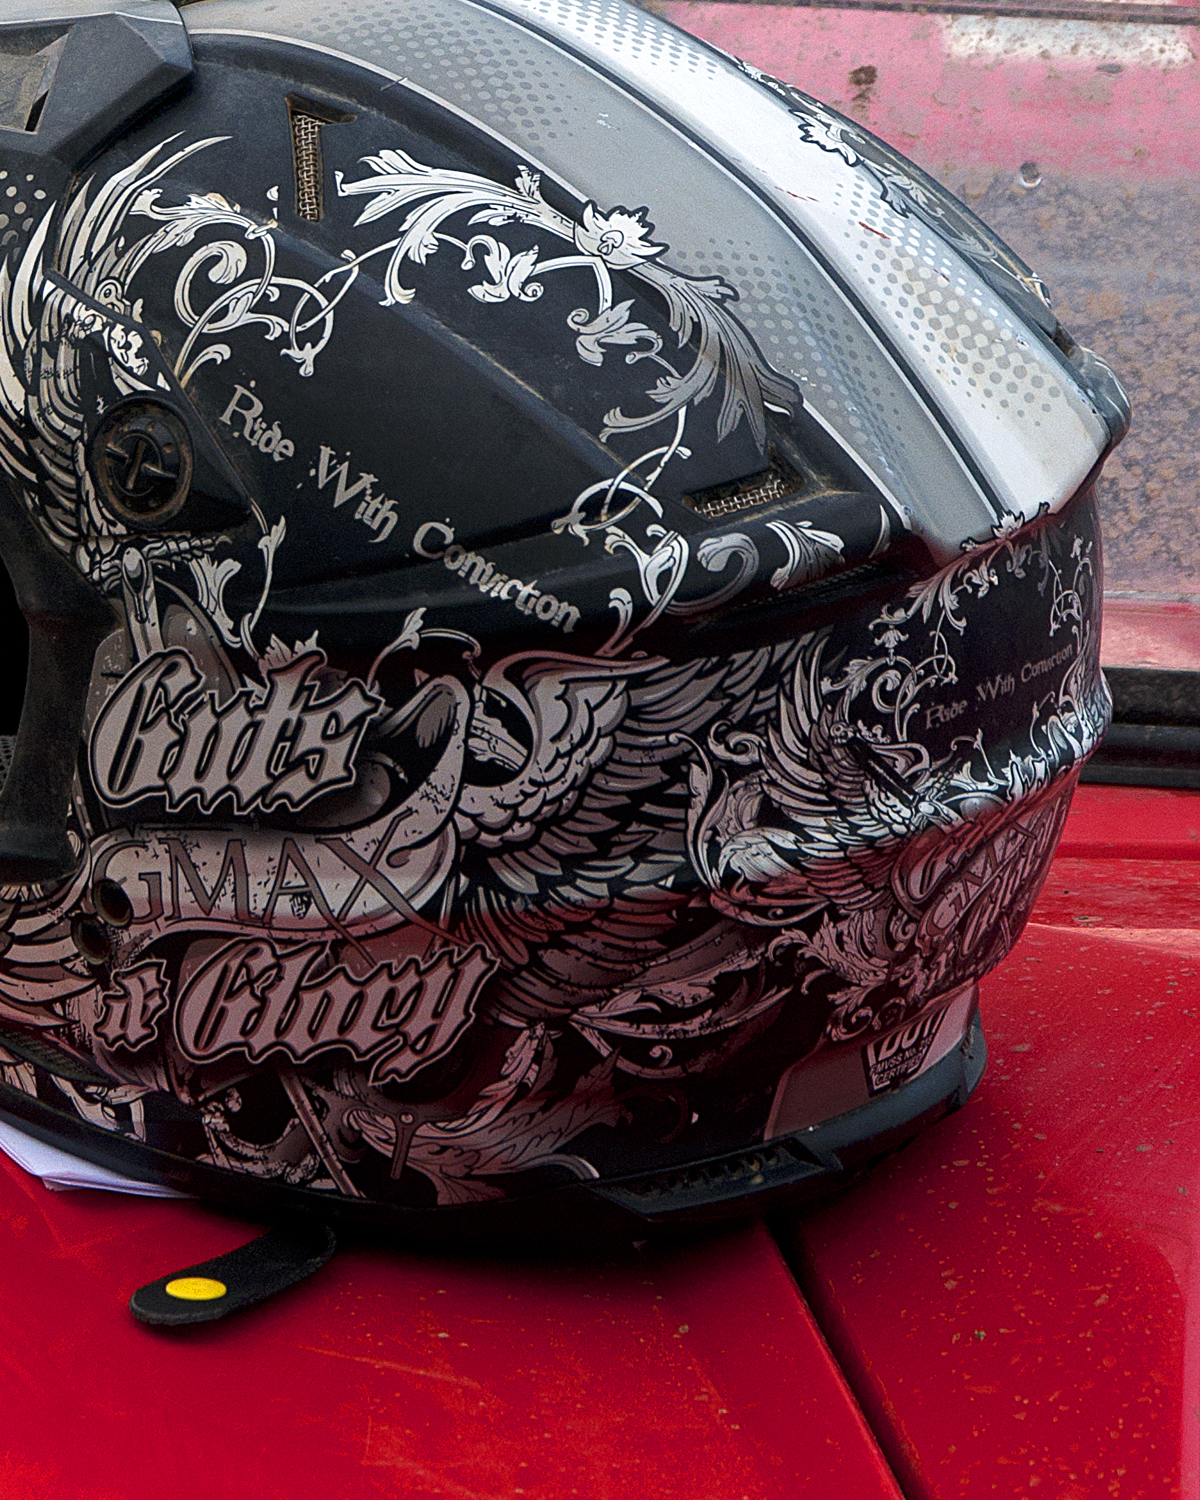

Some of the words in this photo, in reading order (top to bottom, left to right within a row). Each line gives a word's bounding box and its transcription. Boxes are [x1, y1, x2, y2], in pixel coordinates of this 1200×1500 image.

[219, 384, 294, 462] Ride
[316, 445, 398, 543] With
[413, 520, 582, 633] Conviction
[89, 649, 383, 812] Guts
[925, 700, 968, 730] Ride
[976, 674, 1015, 701] With
[92, 808, 468, 964] GMAX
[174, 939, 498, 1084] Glory
